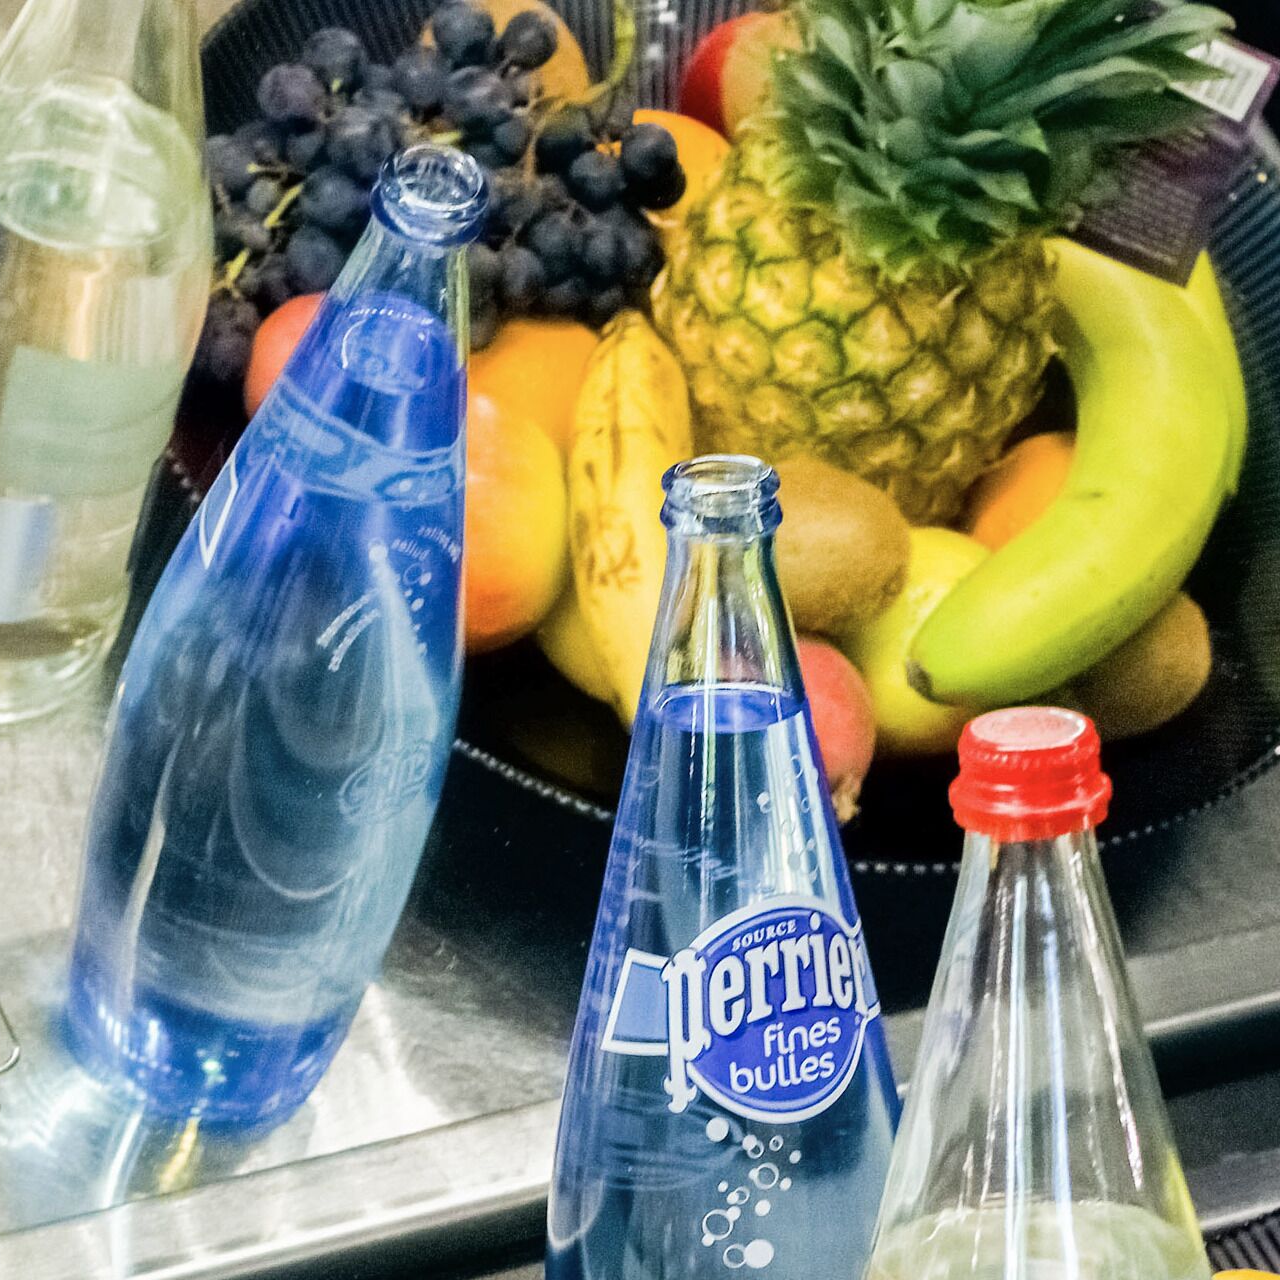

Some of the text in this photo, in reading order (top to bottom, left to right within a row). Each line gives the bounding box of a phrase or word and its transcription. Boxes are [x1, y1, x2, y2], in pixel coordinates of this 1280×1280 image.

[731, 919, 797, 951] SOURCE
[661, 912, 869, 1113] Perrier
[763, 1016, 841, 1057] fines
[729, 1051, 835, 1094] bulles
